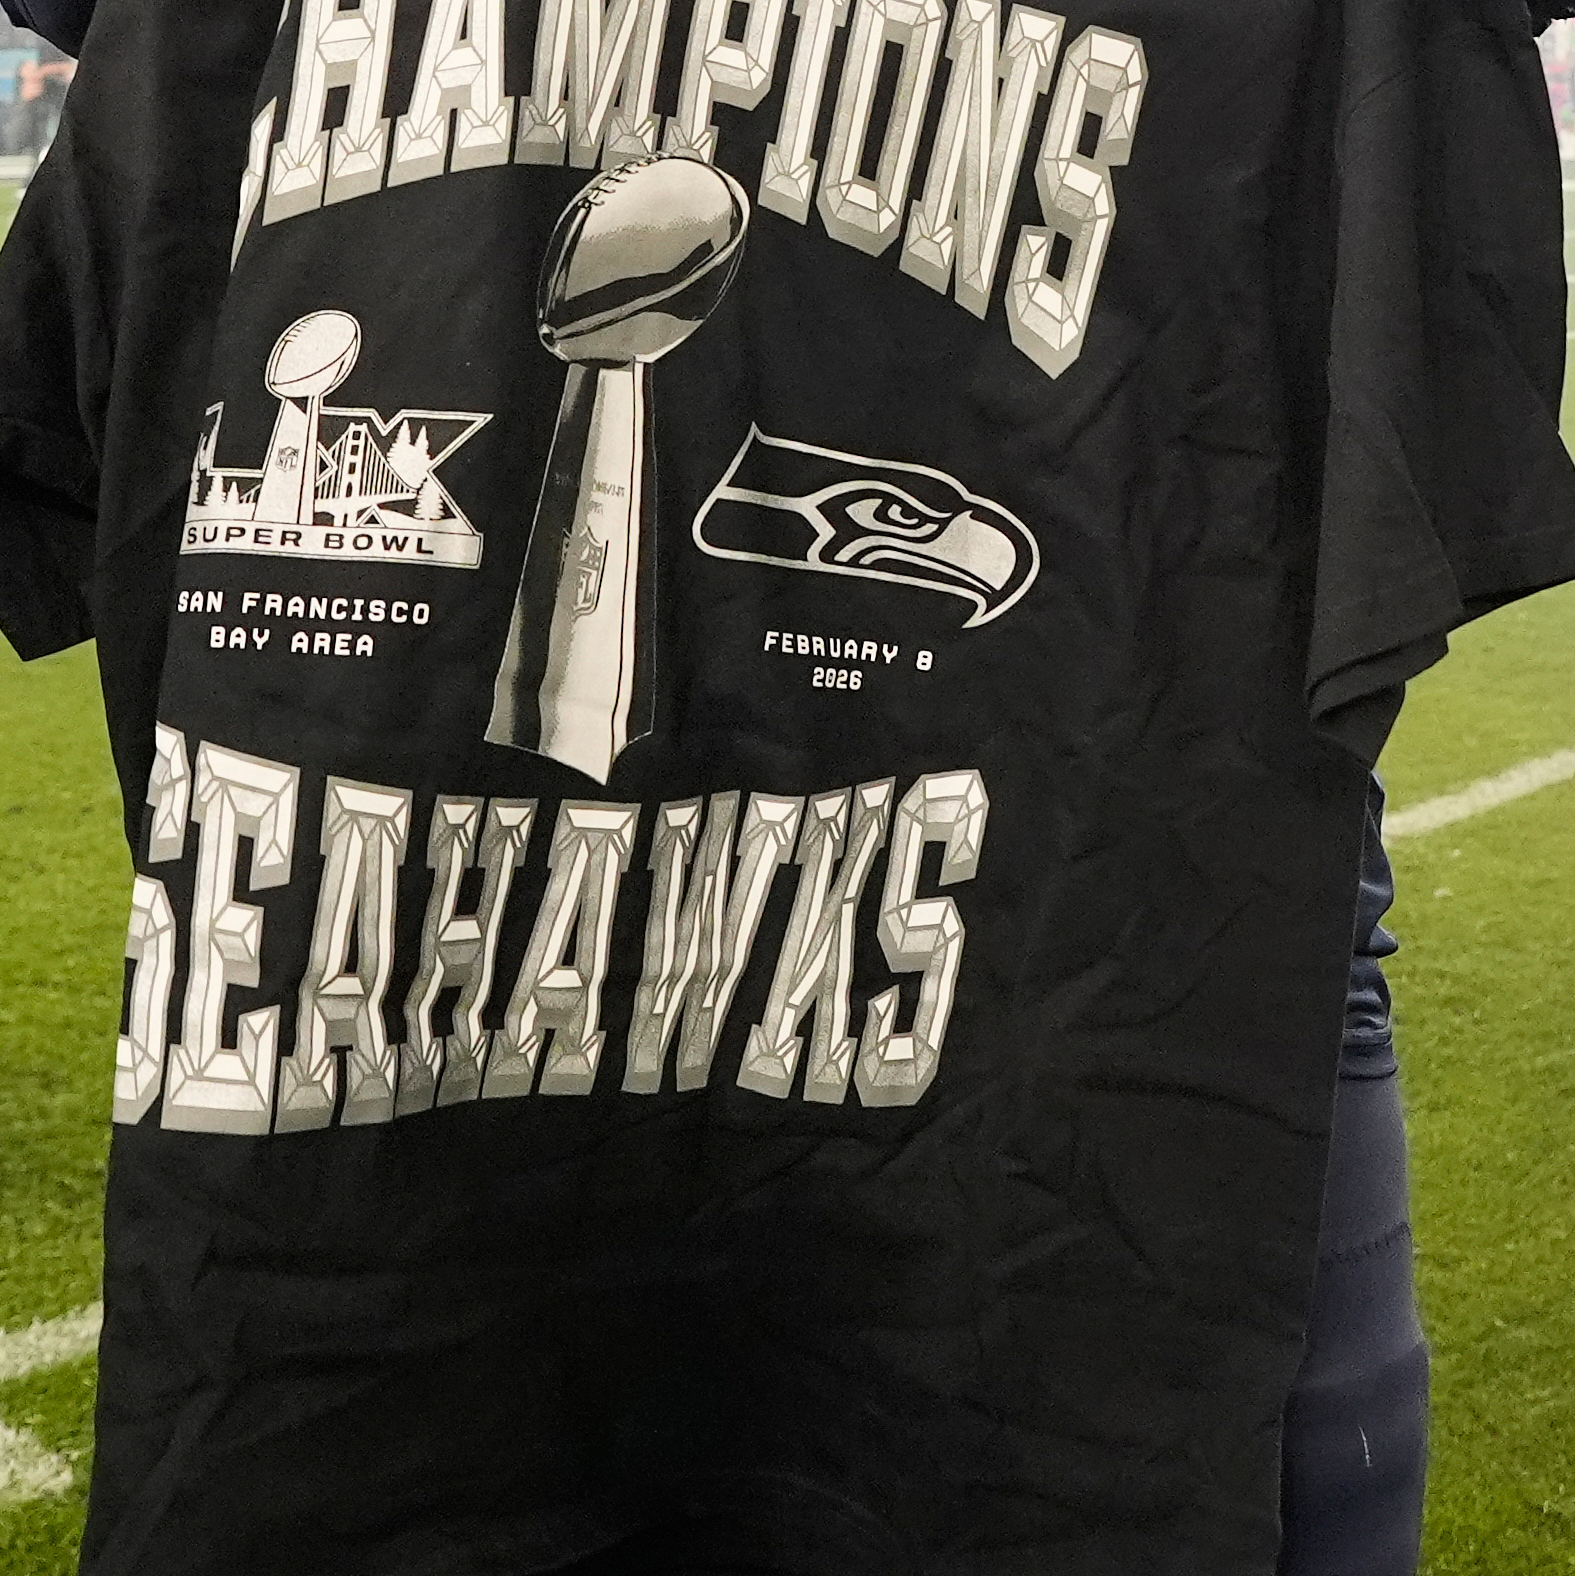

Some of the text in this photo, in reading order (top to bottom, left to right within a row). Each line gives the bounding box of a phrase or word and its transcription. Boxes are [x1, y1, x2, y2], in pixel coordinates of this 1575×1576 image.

[186, 525, 435, 555] SUPER BOWL
[177, 590, 431, 626] SAN FRANCISCO
[210, 626, 375, 658] BAY AREA
[763, 631, 935, 672] FEBRUARY 8
[812, 667, 863, 691] 2026
